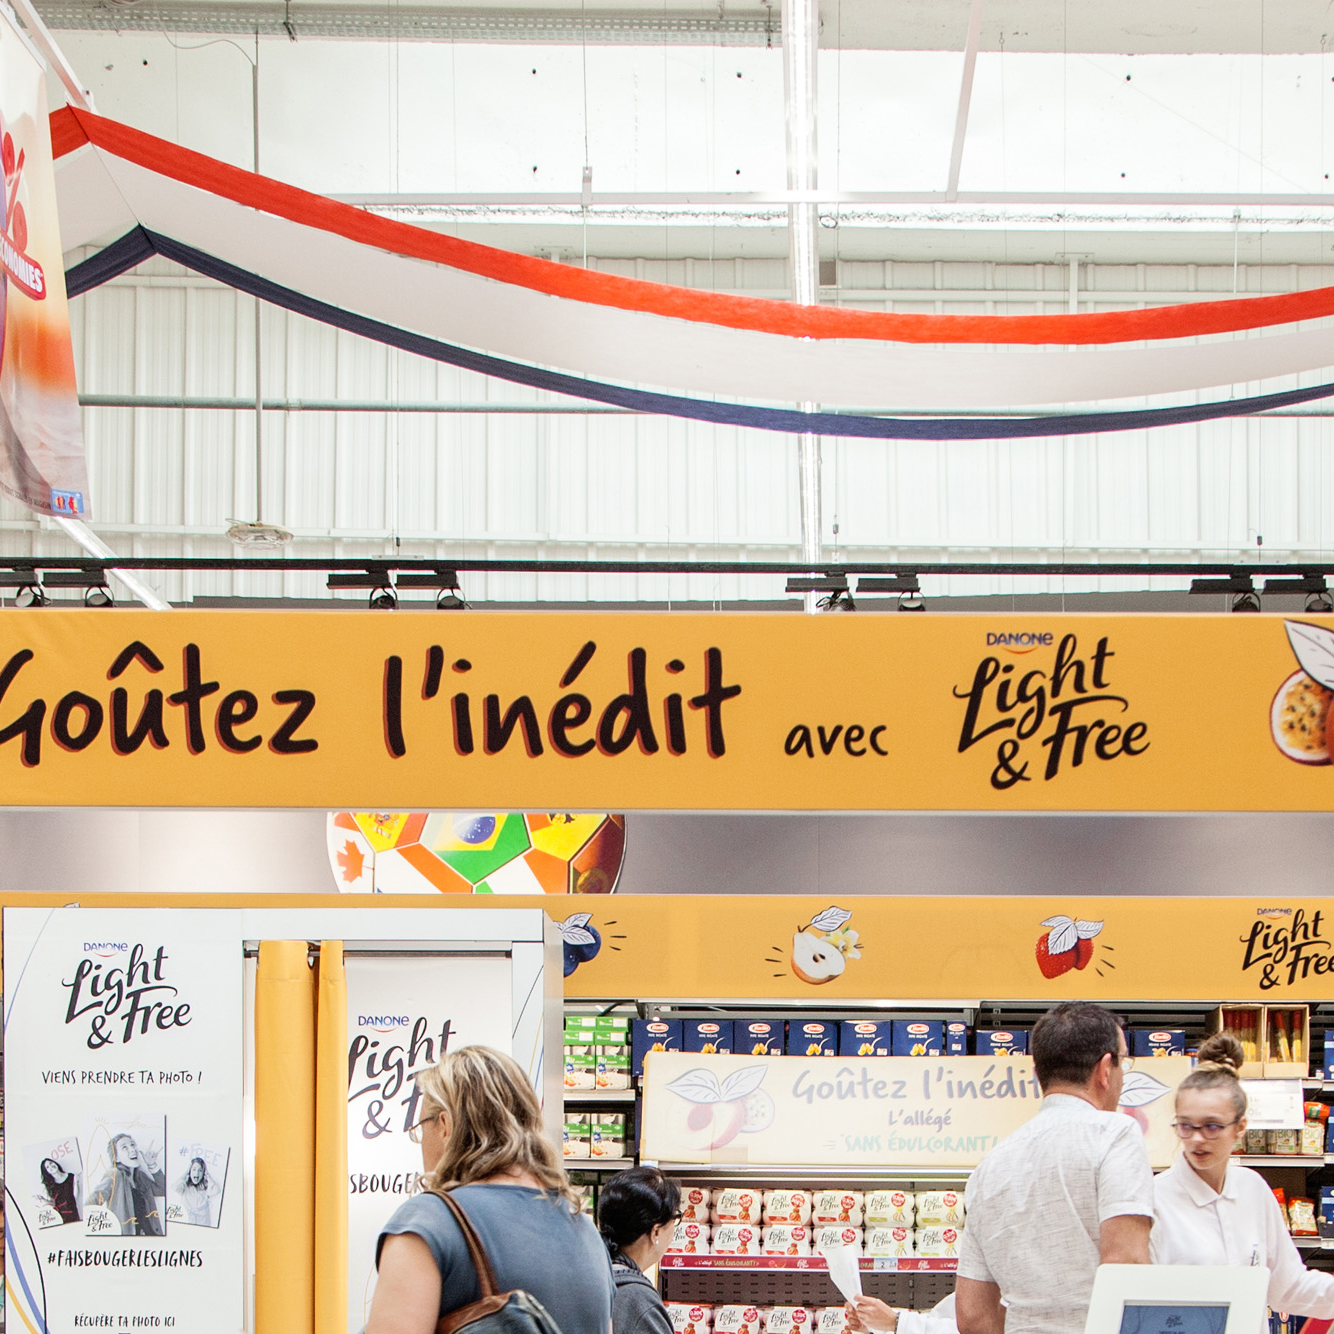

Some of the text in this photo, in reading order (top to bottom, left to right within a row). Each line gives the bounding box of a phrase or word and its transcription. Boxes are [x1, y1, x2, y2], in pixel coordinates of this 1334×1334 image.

[986, 632, 1054, 647] DANONE
[382, 640, 742, 758] l'inédit
[784, 723, 889, 757] avec
[953, 633, 1116, 753] Light
[990, 694, 1150, 789] & Free
[84, 943, 128, 951] DANONE
[1240, 908, 1324, 970] Light
[62, 944, 168, 1024] Light
[1260, 964, 1280, 989] &
[87, 985, 192, 1049] & Free
[358, 1016, 410, 1027] DANONE
[42, 1071, 76, 1084] VIENS
[82, 1070, 135, 1084] PRENDRE
[139, 1071, 154, 1084] TA
[159, 1071, 193, 1084] PHOTO
[792, 1066, 906, 1105] Goûtez
[362, 1100, 392, 1140] &
[888, 1108, 952, 1132] L'allégé
[47, 1250, 203, 1268] #FAISBOUGERLESLIGNES
[74, 1313, 175, 1327] RÉCUPÈRE TA PHOTO ICI
